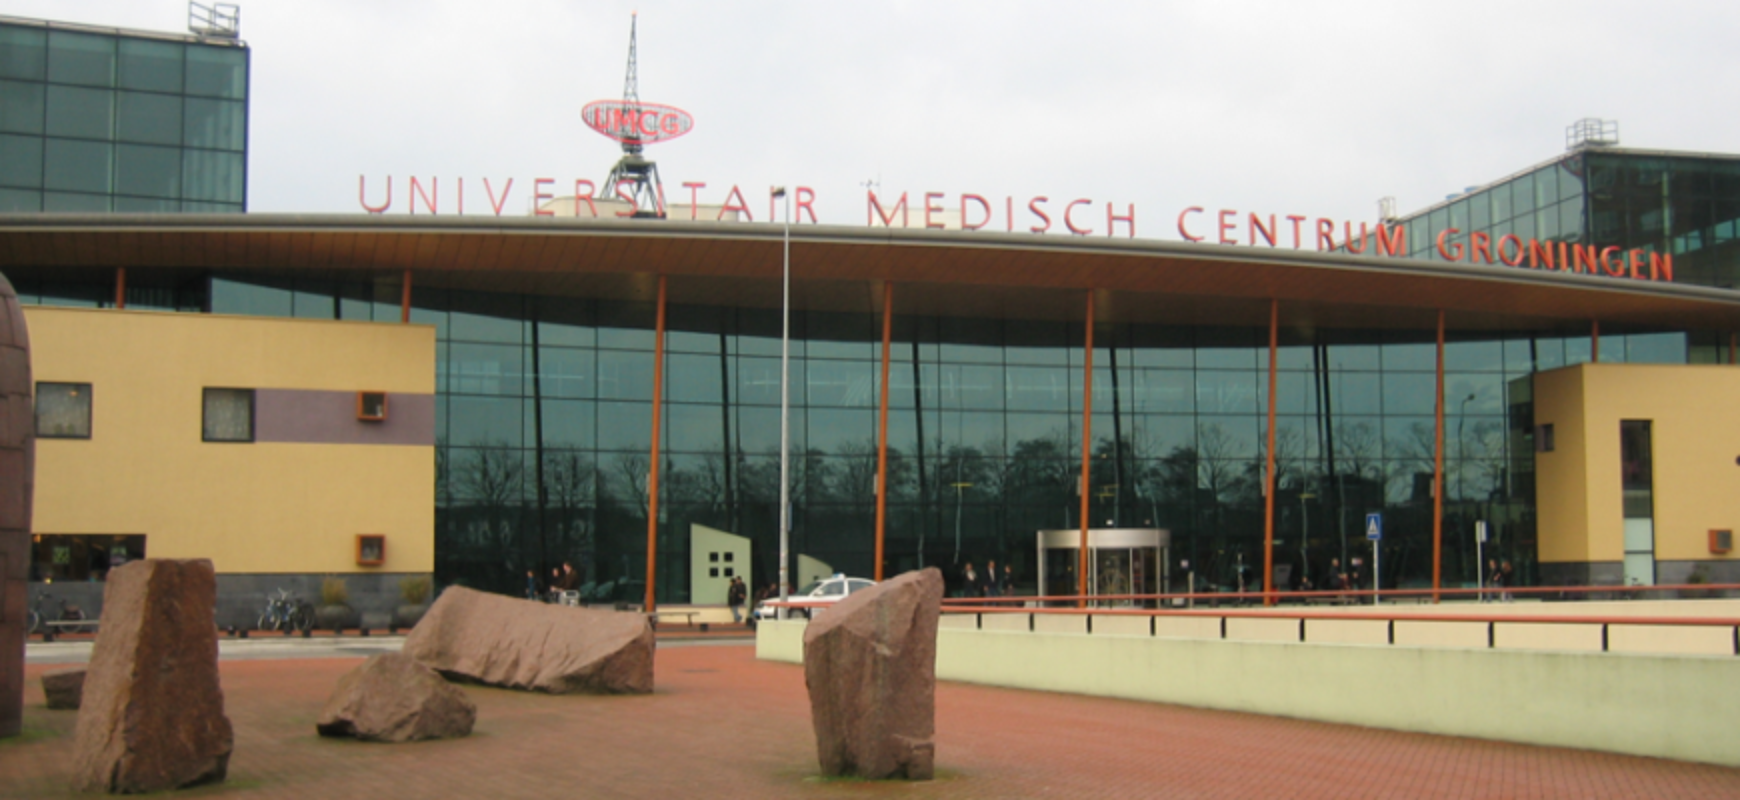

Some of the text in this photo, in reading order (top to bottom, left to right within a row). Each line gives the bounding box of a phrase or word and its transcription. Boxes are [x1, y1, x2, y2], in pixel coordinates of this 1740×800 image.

[594, 107, 680, 136] UMCG
[359, 175, 1673, 281] UNIVERSITAIR MEDISCH CENTRUM GRONINGEN
